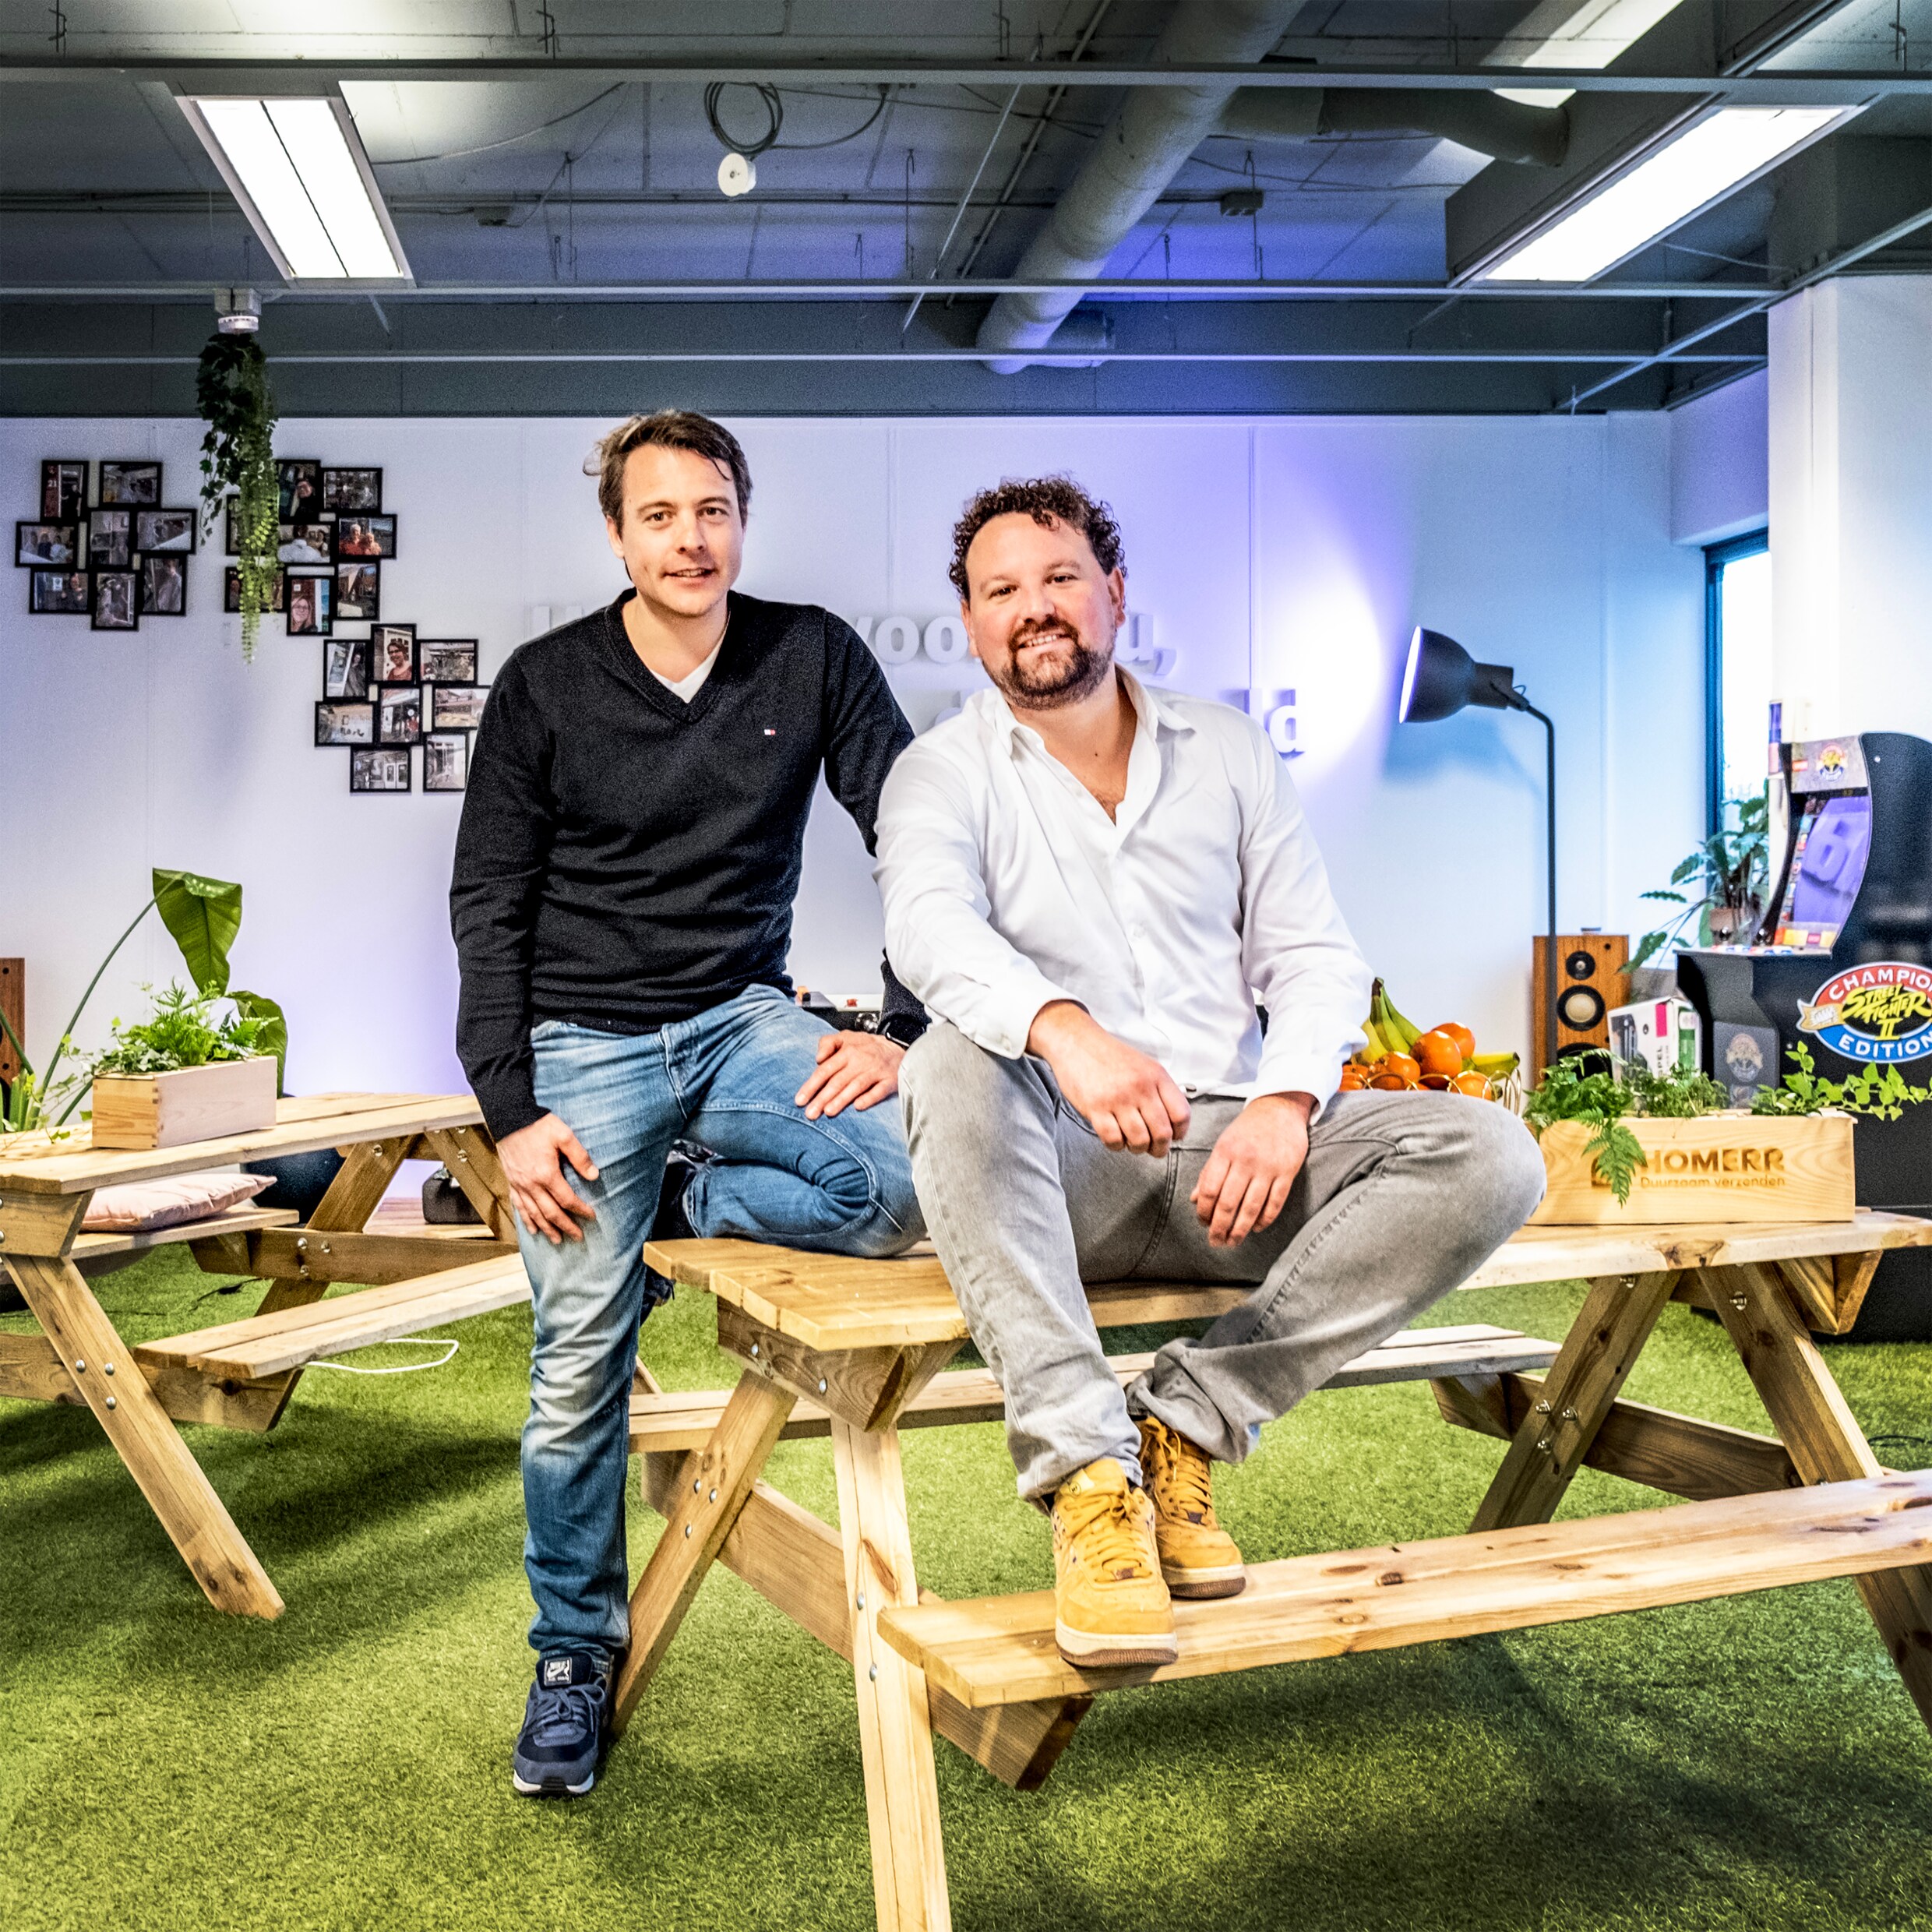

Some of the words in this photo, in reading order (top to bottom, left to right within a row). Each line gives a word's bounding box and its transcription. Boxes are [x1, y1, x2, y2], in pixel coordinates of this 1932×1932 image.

[1829, 968, 1932, 1000] CHAMPIO
[1842, 983, 1903, 1020] STREET
[1853, 991, 1932, 1024] FIGHTER
[1874, 1018, 1903, 1041] II
[1640, 1148, 1785, 1173] HOMERR
[1641, 1177, 1709, 1188] Duurzaam
[1714, 1175, 1785, 1187] verzenden
